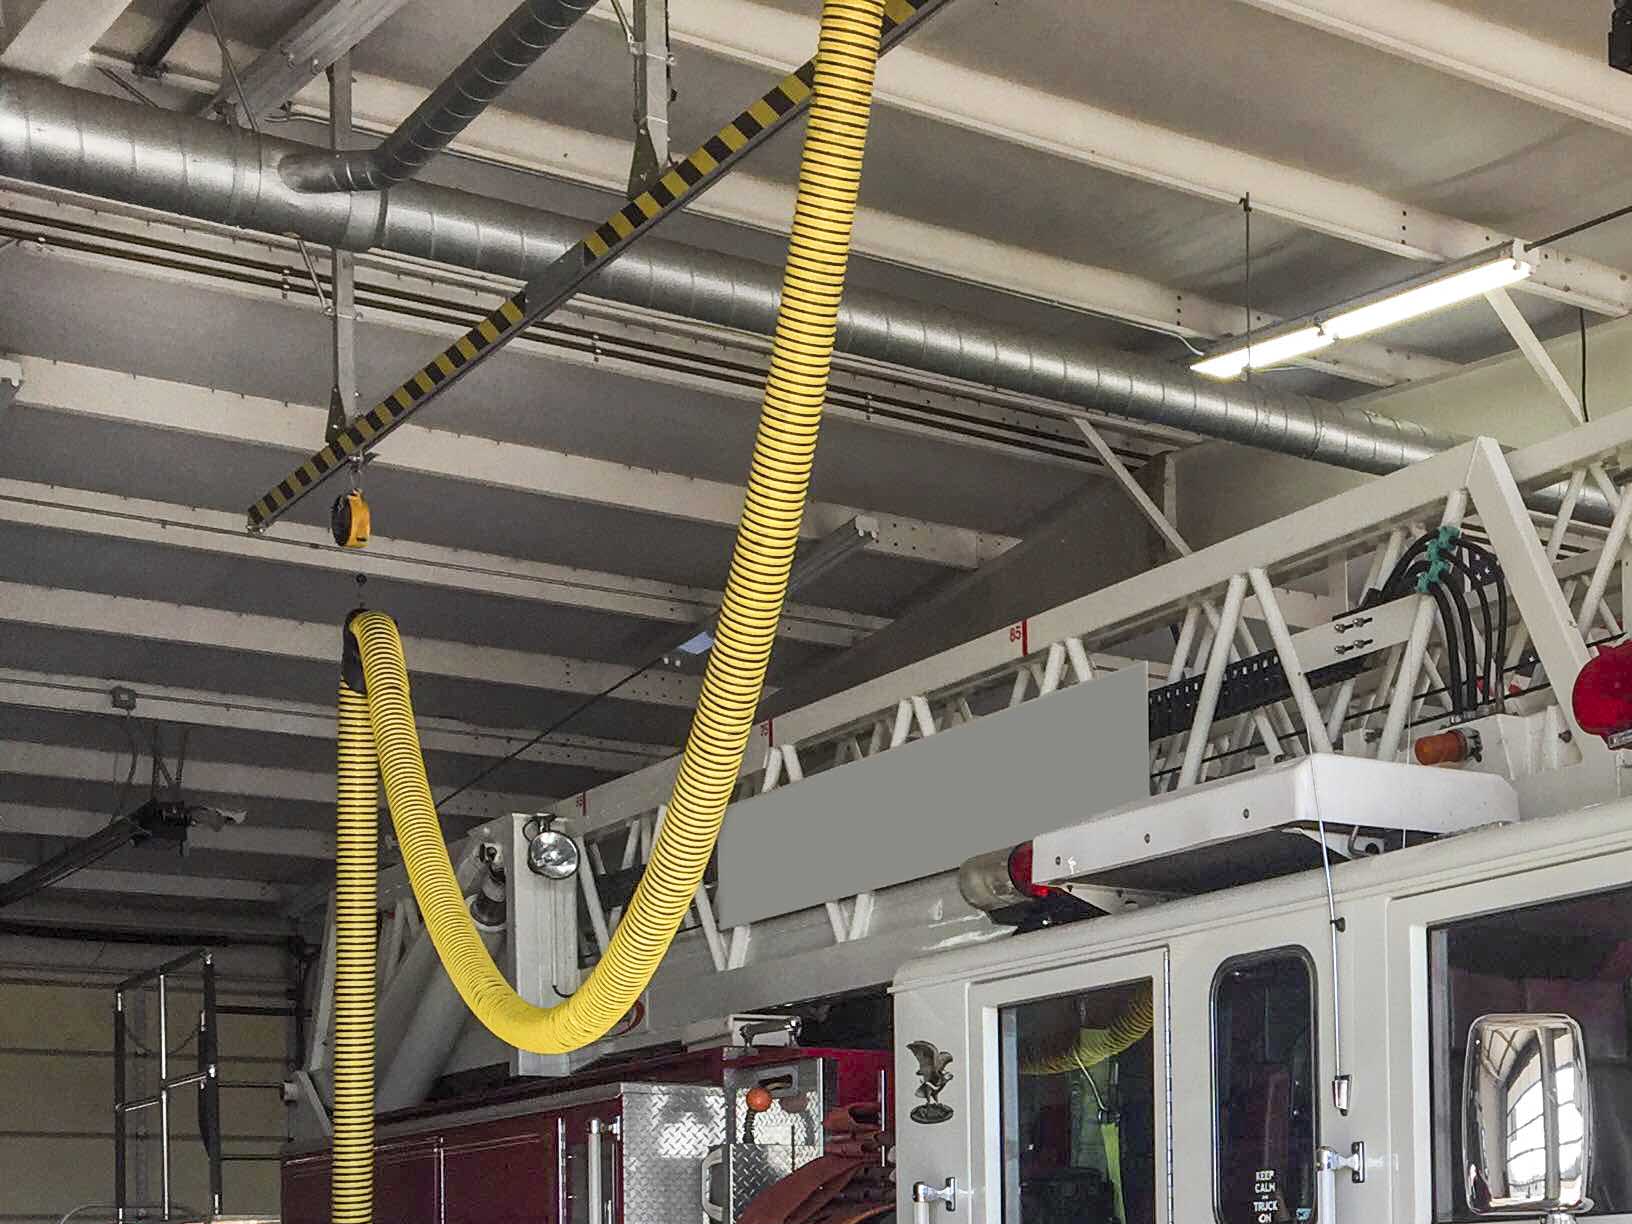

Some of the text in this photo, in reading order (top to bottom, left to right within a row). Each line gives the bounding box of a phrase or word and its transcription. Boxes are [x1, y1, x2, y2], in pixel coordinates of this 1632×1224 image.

[1010, 625, 1021, 642] 85
[1255, 1170, 1275, 1181] KEEP
[1255, 1182, 1276, 1193] CALM
[1253, 1200, 1278, 1212] TRUCK
[1258, 1213, 1272, 1223] ON
